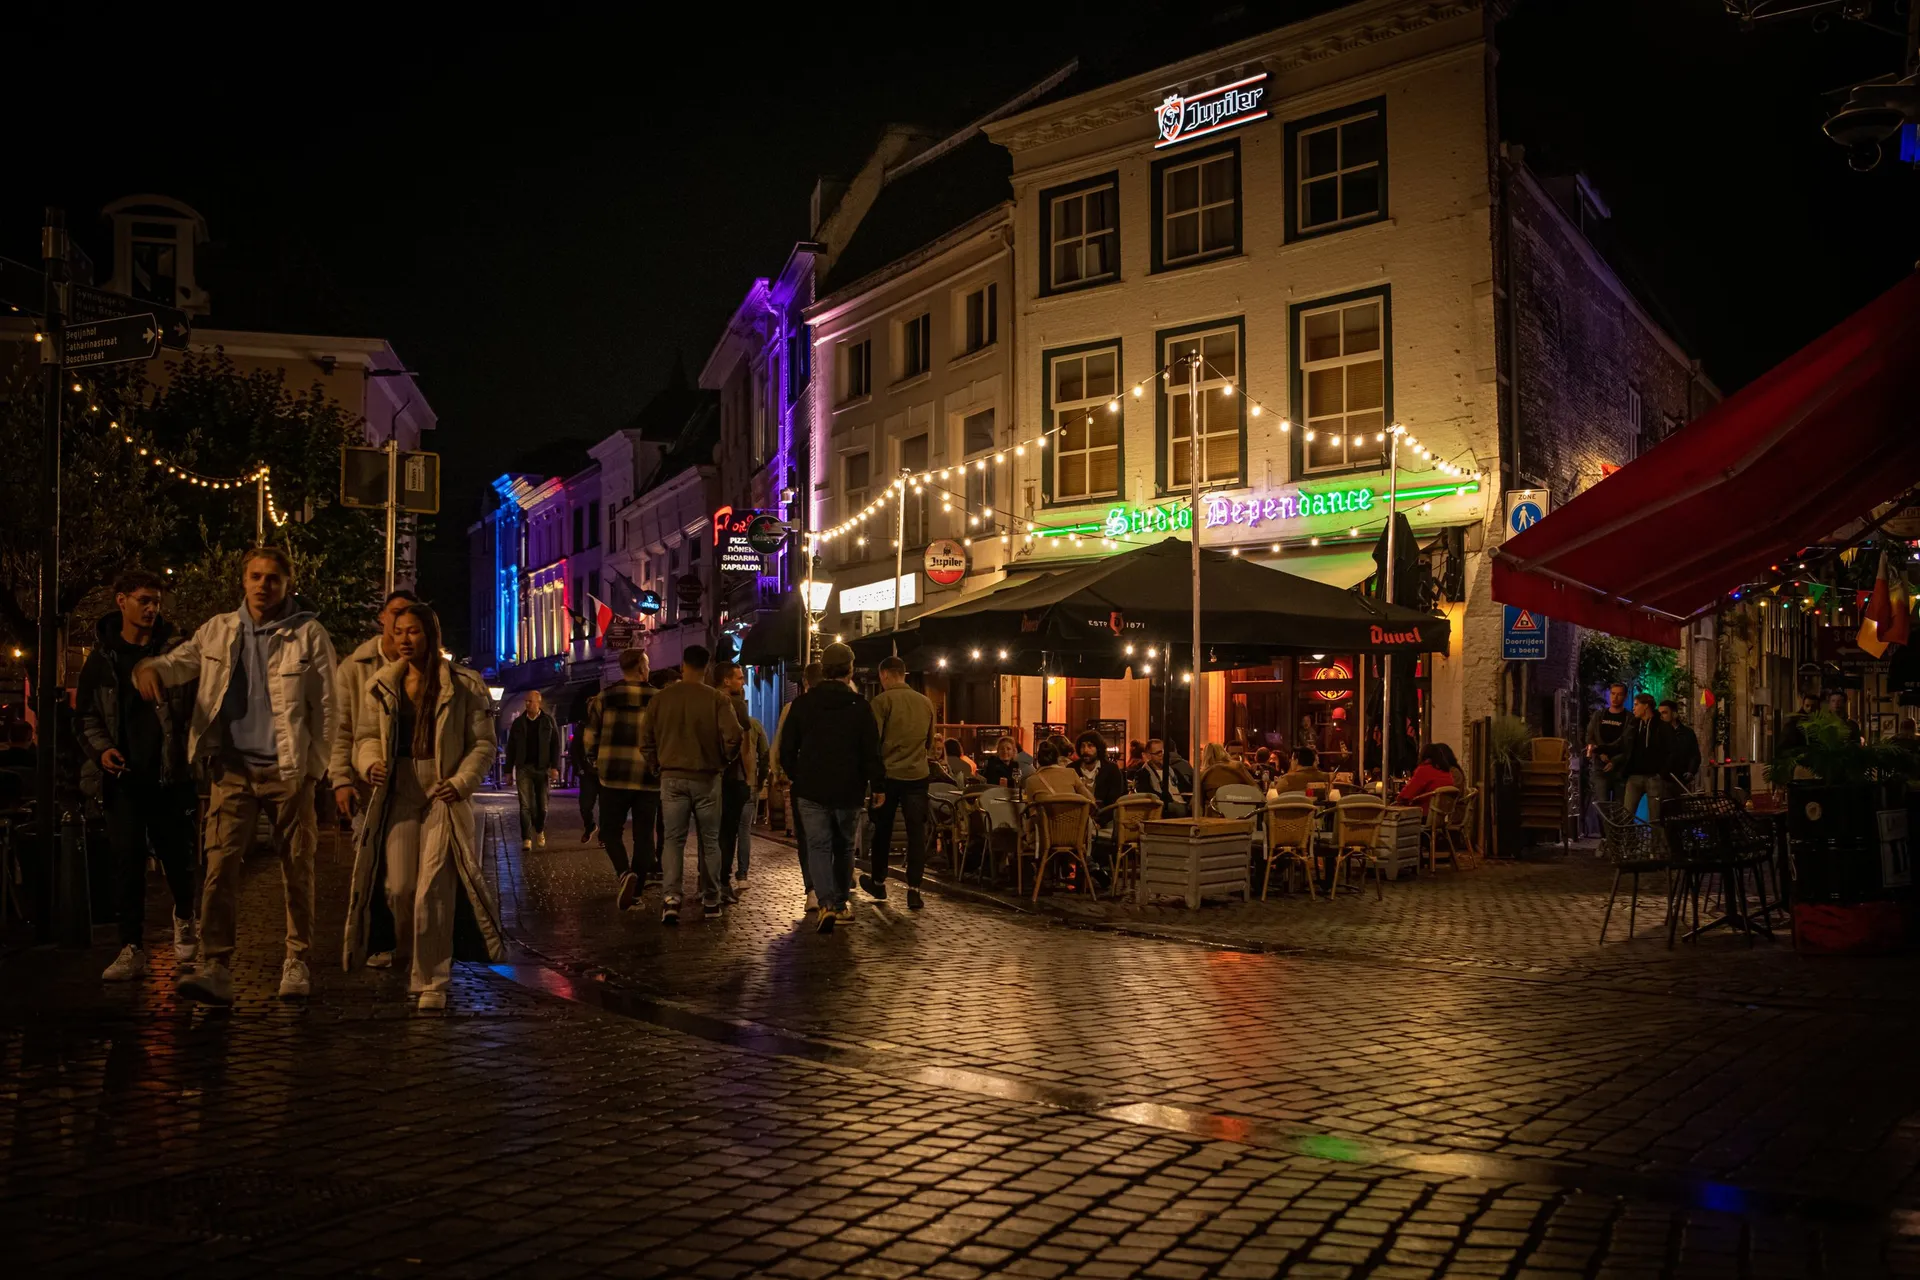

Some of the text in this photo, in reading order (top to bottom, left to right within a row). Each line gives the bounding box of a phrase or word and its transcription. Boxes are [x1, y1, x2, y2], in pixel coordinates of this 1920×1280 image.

[1184, 87, 1264, 131] Jupiler
[65, 327, 98, 340] Begijnhof
[65, 336, 118, 352] Catharinastraat
[65, 350, 105, 364] Boschstraat
[1104, 488, 1373, 537] Studio Dependance
[729, 536, 749, 545] PIZZ
[722, 554, 760, 562] SHOARMA
[929, 556, 963, 568] Jupiler
[720, 563, 762, 571] KAPSALON
[1125, 621, 1145, 629] 1871
[1369, 624, 1422, 645] Duvel
[1505, 638, 1544, 646] Doorrijden
